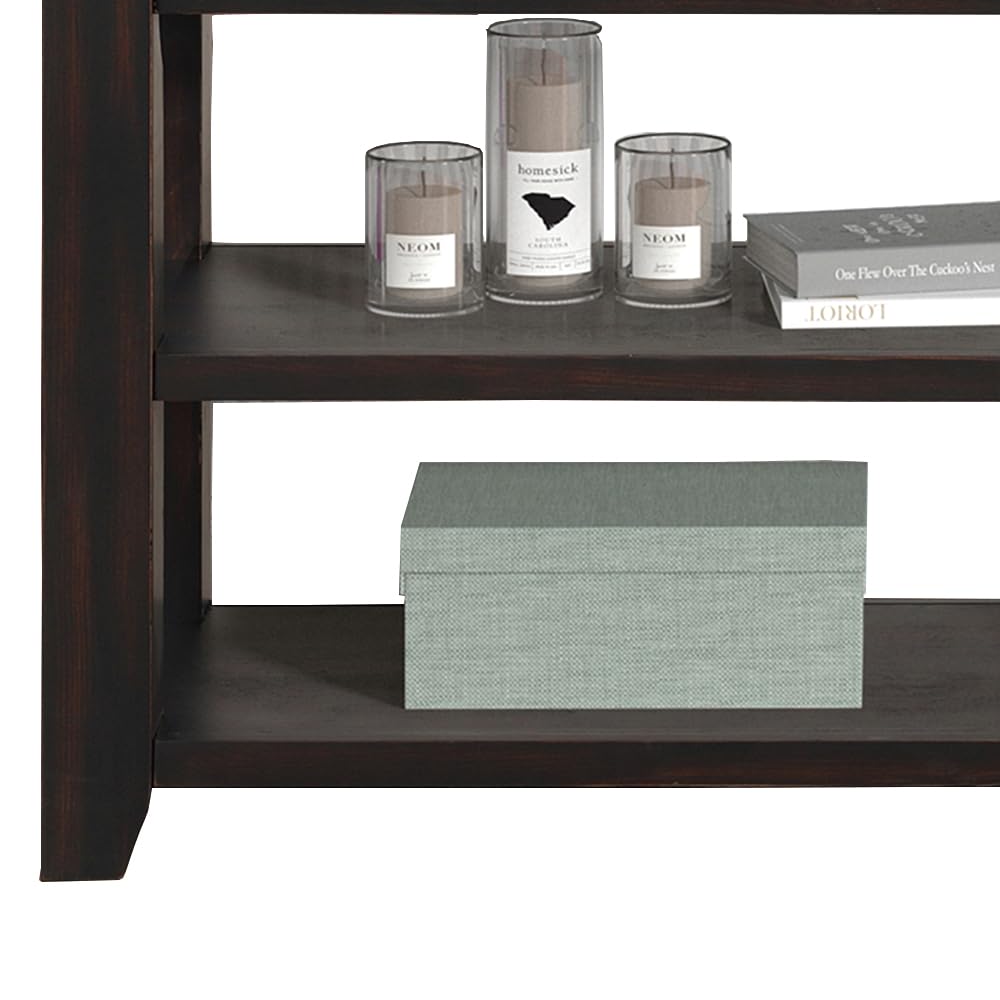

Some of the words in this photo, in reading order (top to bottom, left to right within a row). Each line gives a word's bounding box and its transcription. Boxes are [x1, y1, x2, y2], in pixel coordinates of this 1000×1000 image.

[517, 163, 579, 176] homesick
[642, 233, 686, 244] NEOM
[397, 242, 441, 253] NEOM
[835, 268, 856, 282] One
[858, 266, 881, 281] Flew
[883, 265, 908, 280] Over
[908, 264, 930, 278] The
[931, 261, 971, 278] Cuckoo's
[973, 261, 995, 275] Nest
[805, 303, 886, 322] LORIOT
